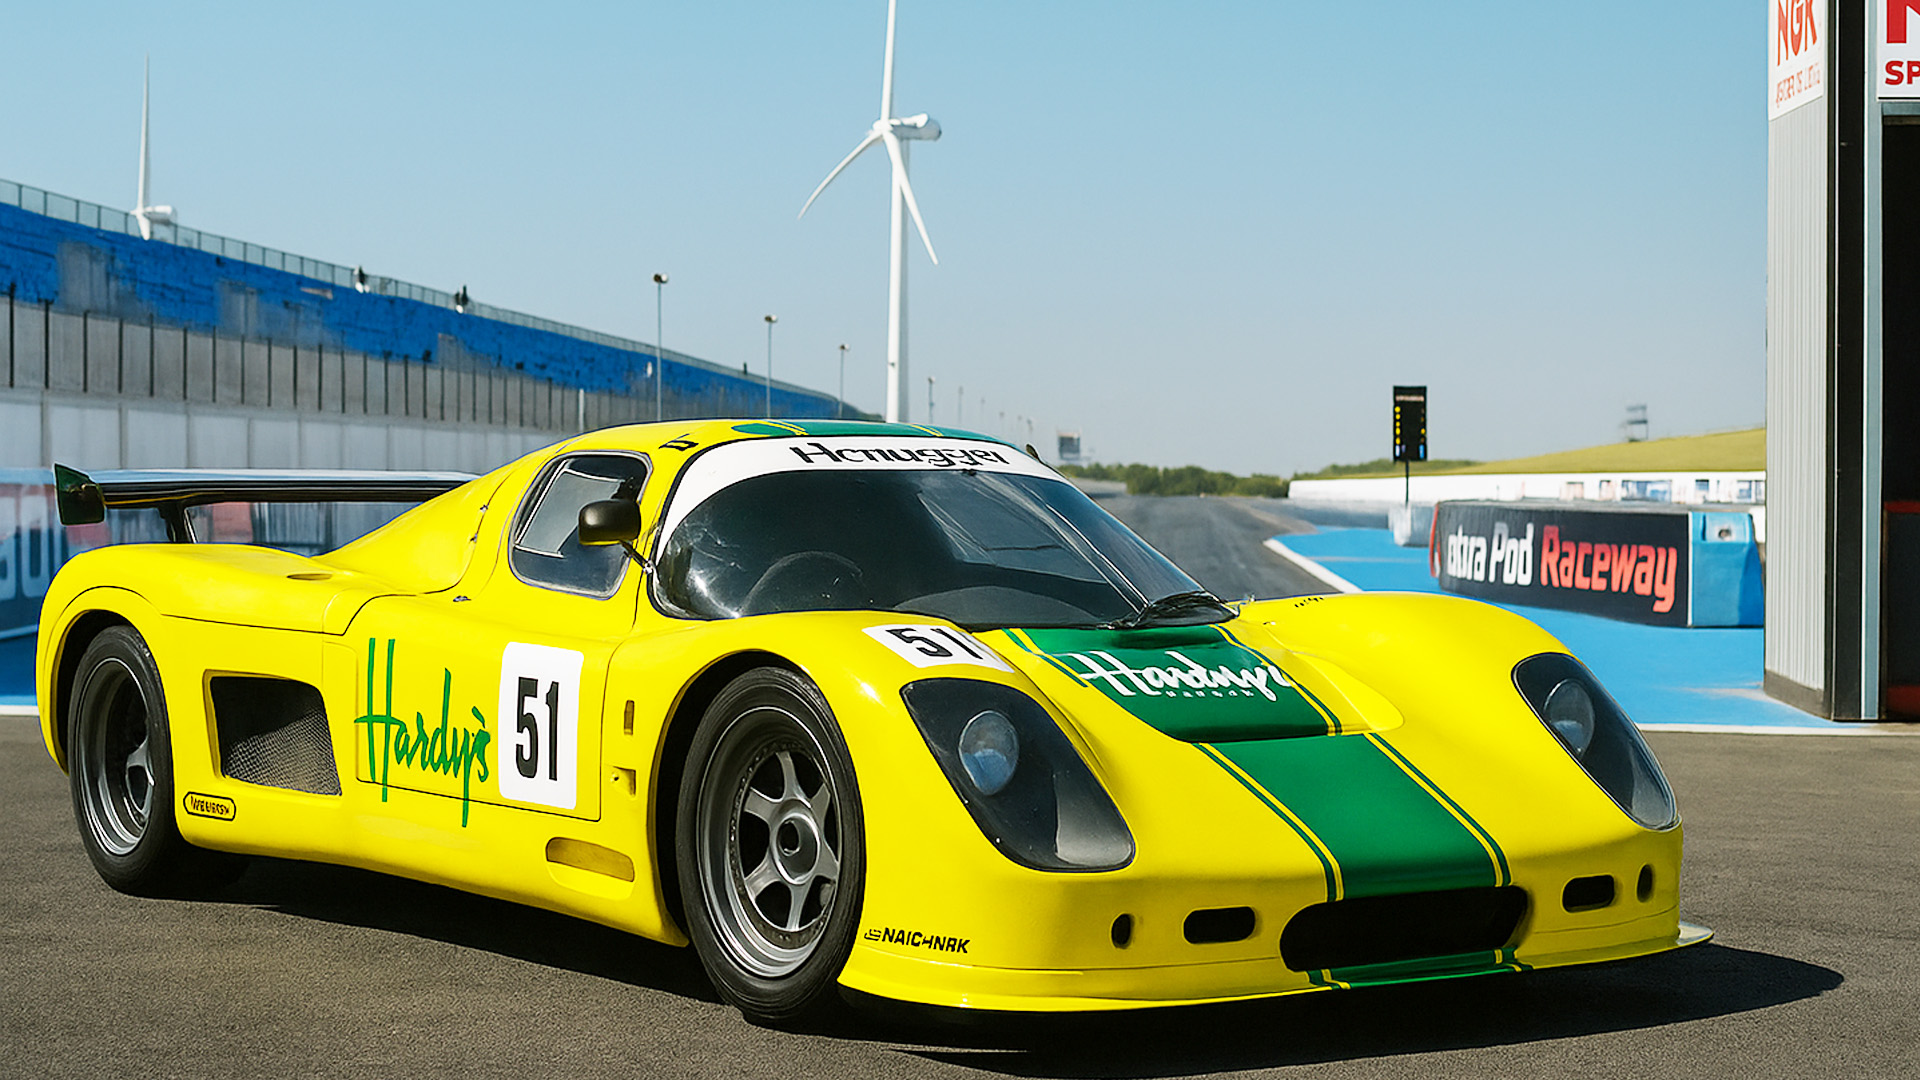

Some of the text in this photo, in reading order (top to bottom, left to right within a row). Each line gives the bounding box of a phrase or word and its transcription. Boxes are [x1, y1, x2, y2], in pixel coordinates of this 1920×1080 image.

[1777, 0, 1817, 66] NGK
[1488, 521, 1534, 586] Pod
[1540, 525, 1677, 612] Raceway
[885, 627, 983, 660] 51
[515, 676, 559, 781] 51
